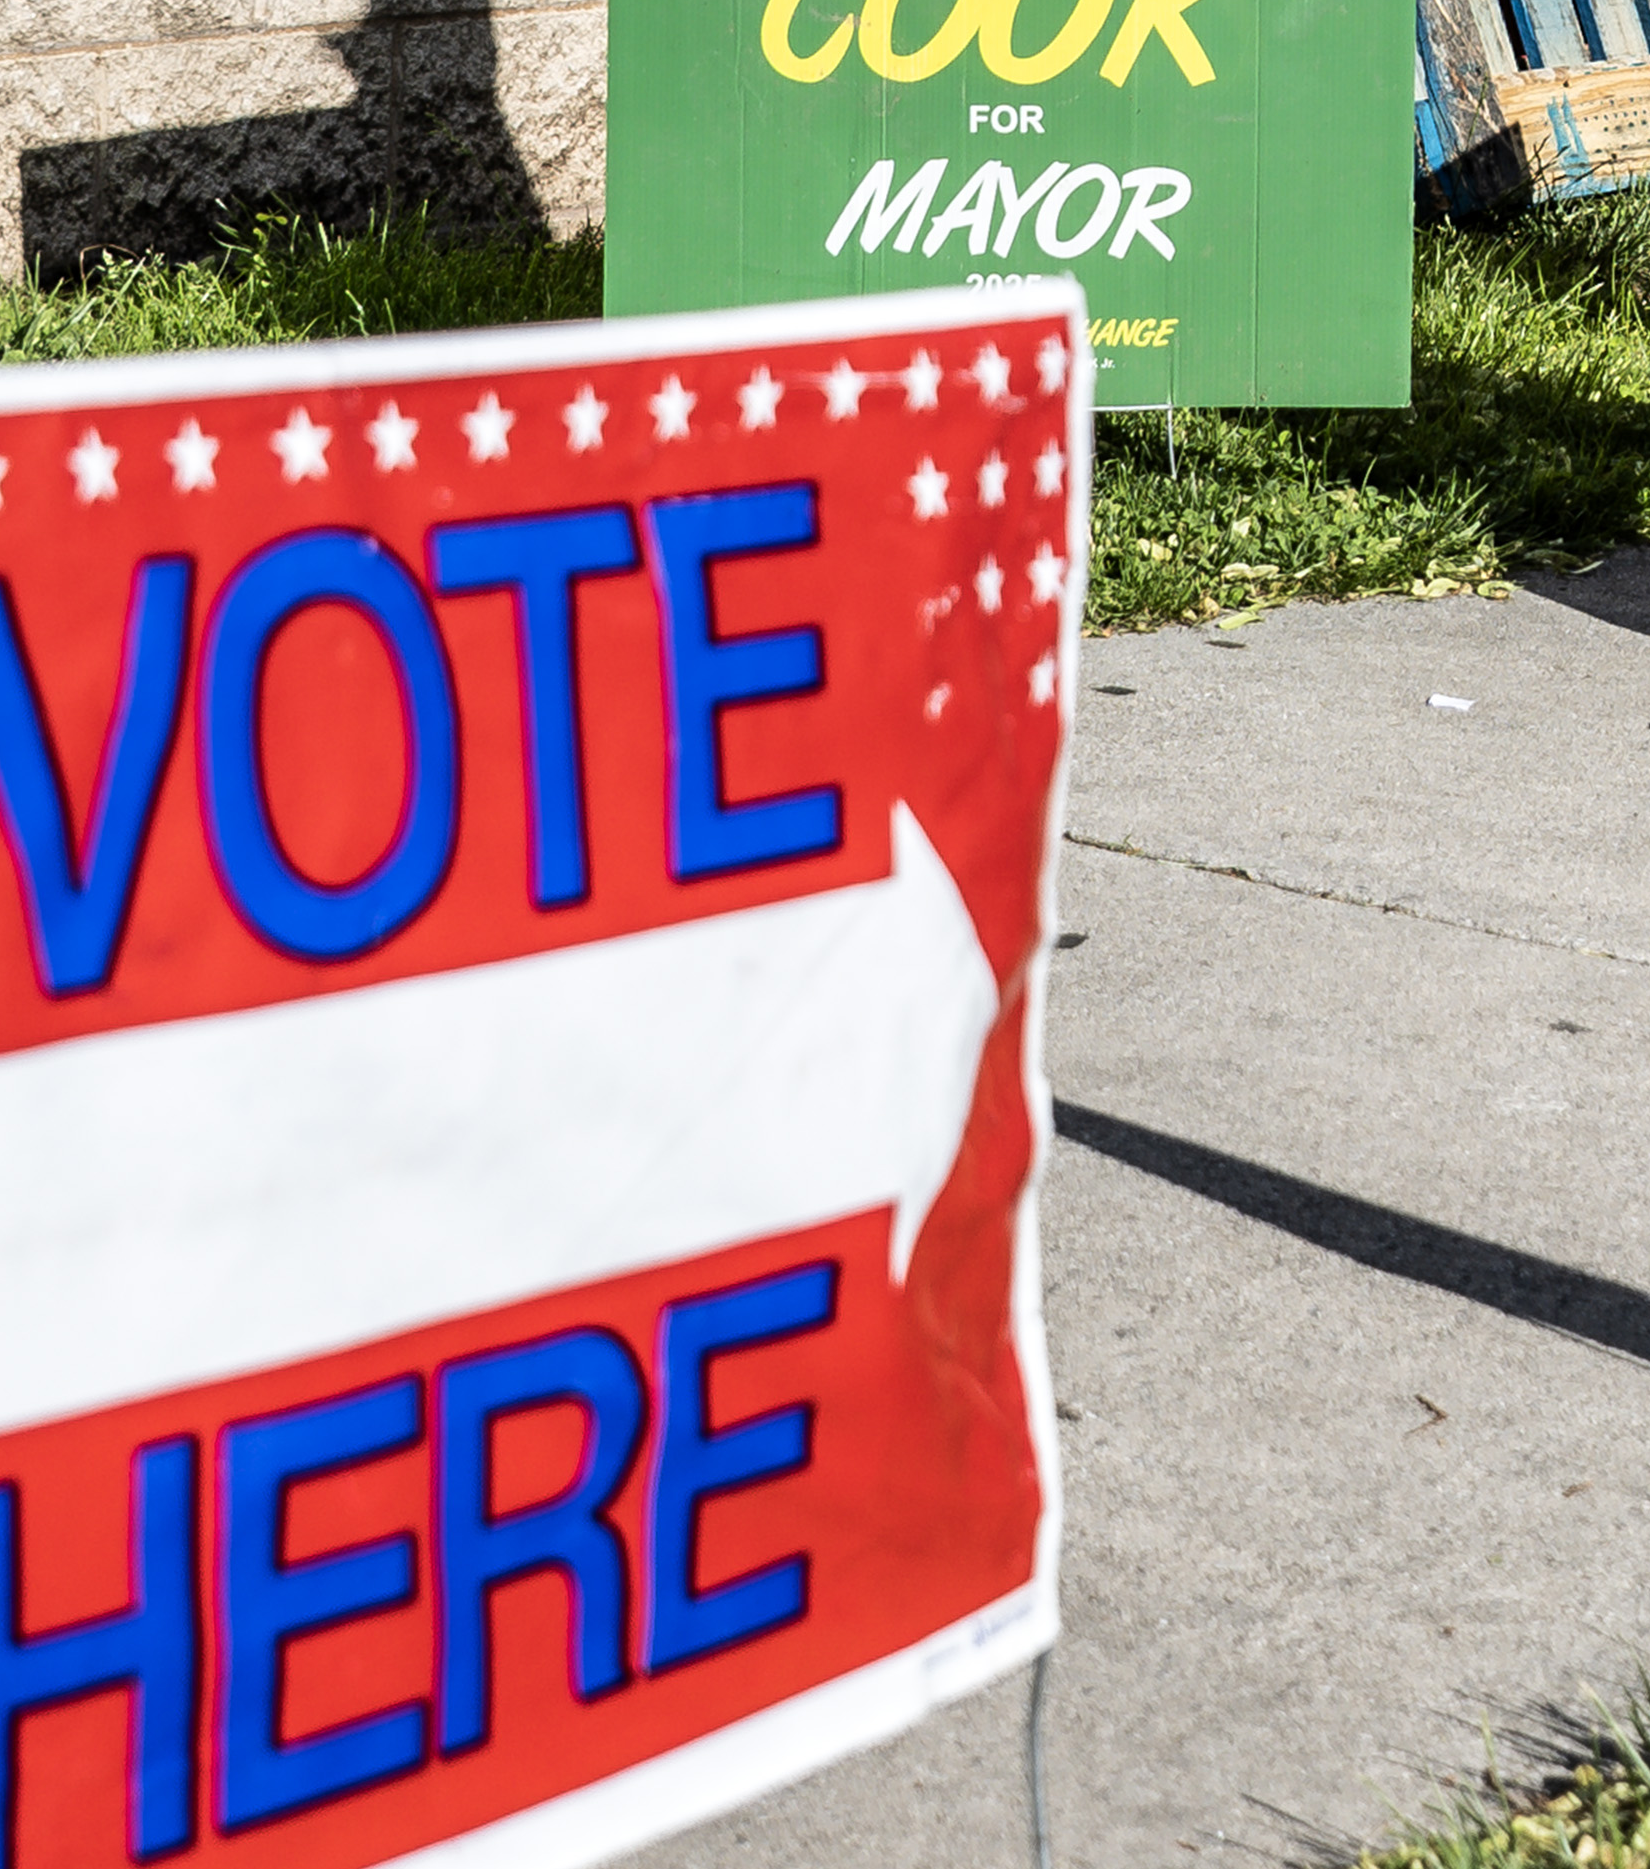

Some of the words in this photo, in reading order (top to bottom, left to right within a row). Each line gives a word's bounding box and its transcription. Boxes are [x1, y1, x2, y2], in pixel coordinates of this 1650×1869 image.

[968, 104, 1046, 134] FOR
[824, 157, 1193, 263] MAYOR
[1085, 318, 1179, 348] HANGE
